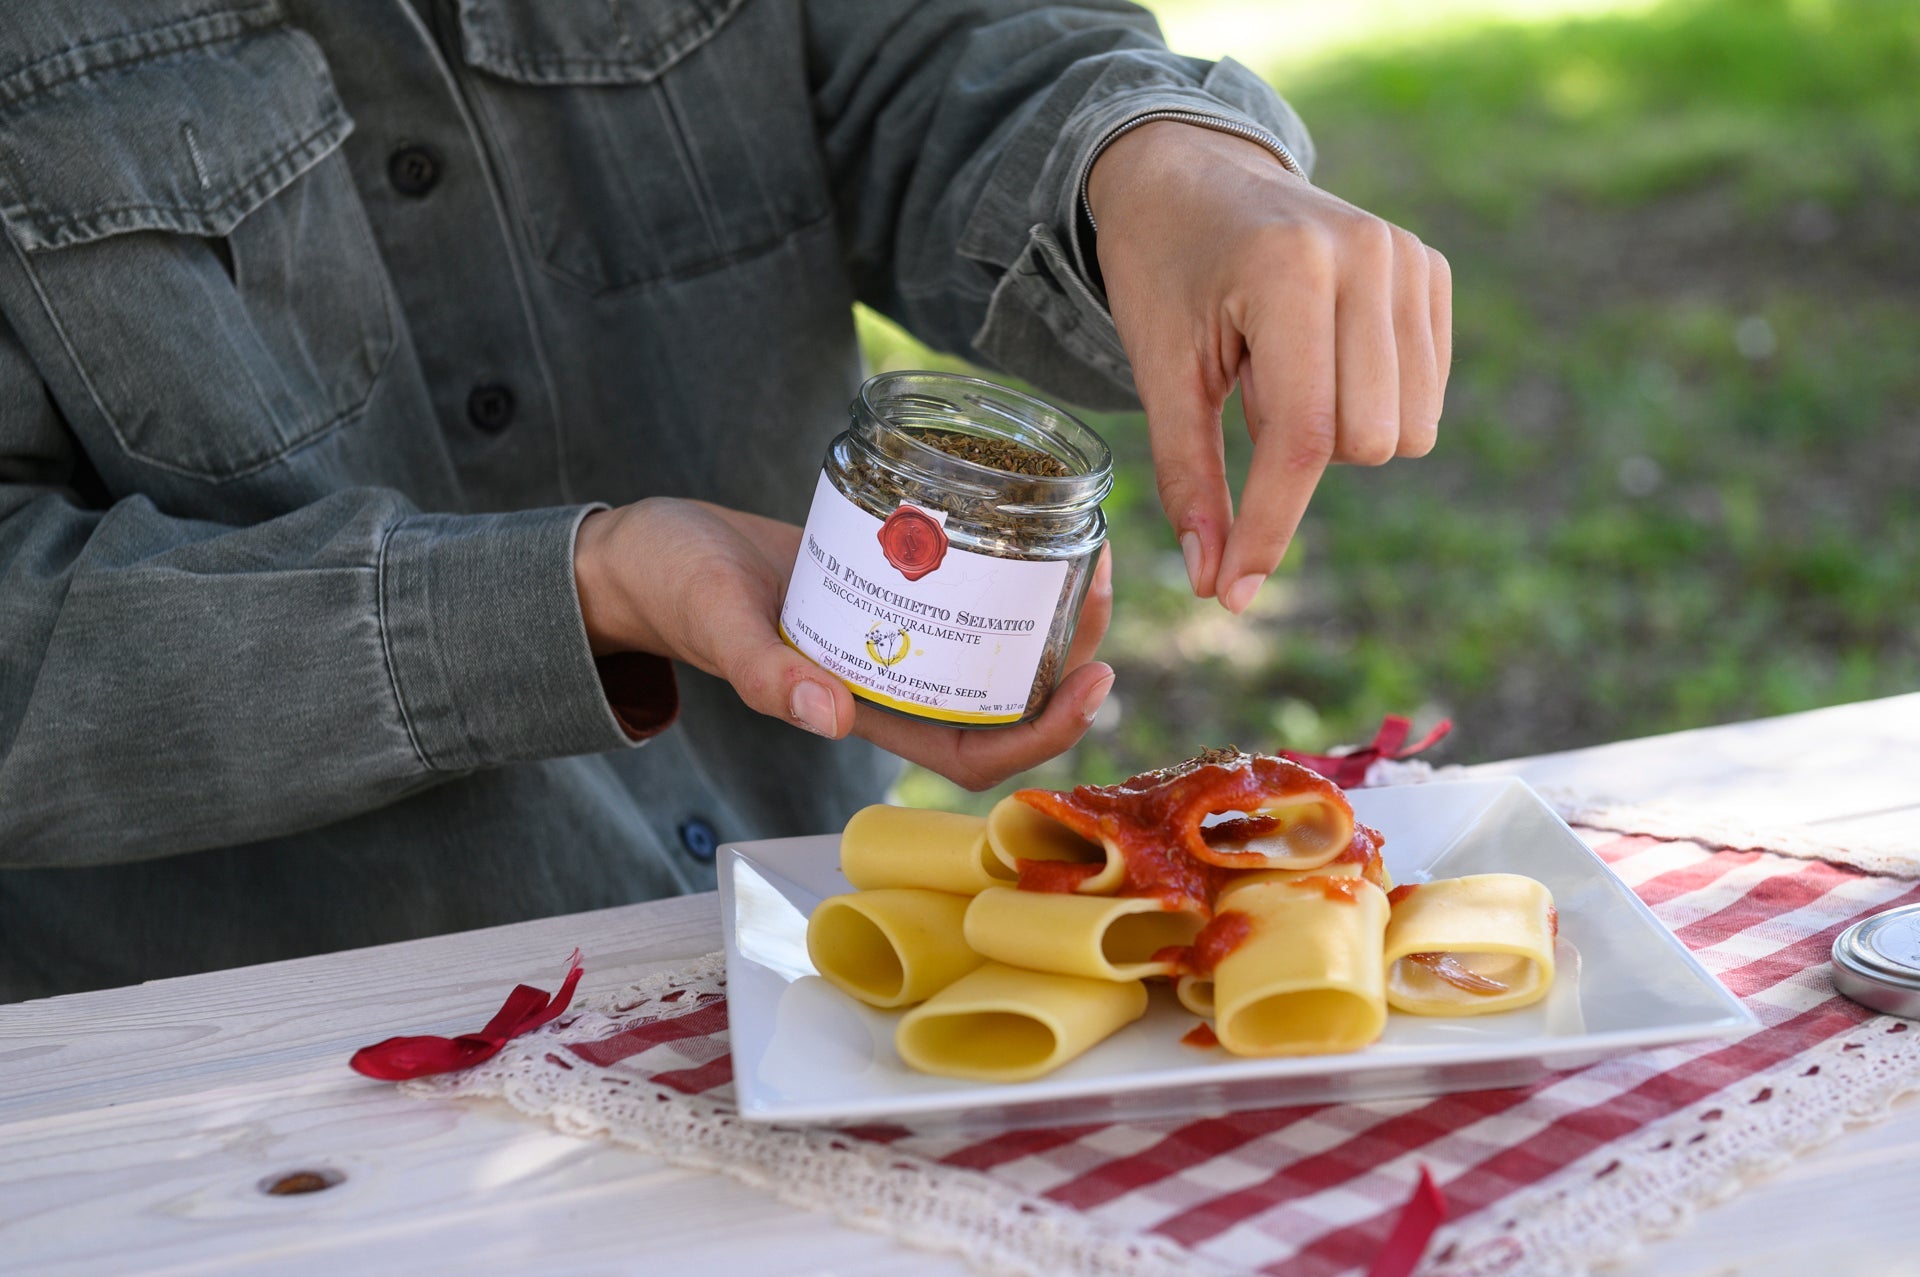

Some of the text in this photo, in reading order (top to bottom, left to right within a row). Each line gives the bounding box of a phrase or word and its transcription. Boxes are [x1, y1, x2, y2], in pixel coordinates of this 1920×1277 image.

[807, 534, 826, 563] SEMI
[843, 566, 951, 622] FINOCCHIETTO
[955, 610, 1035, 632] SELVATICO
[822, 576, 982, 645] ESSICCATI NATURALMENTE
[796, 617, 840, 655] NATURALLY
[840, 650, 872, 671] DRIED
[877, 666, 907, 685] WILD
[908, 677, 953, 695] FENNEL
[955, 687, 988, 699] SEEDS
